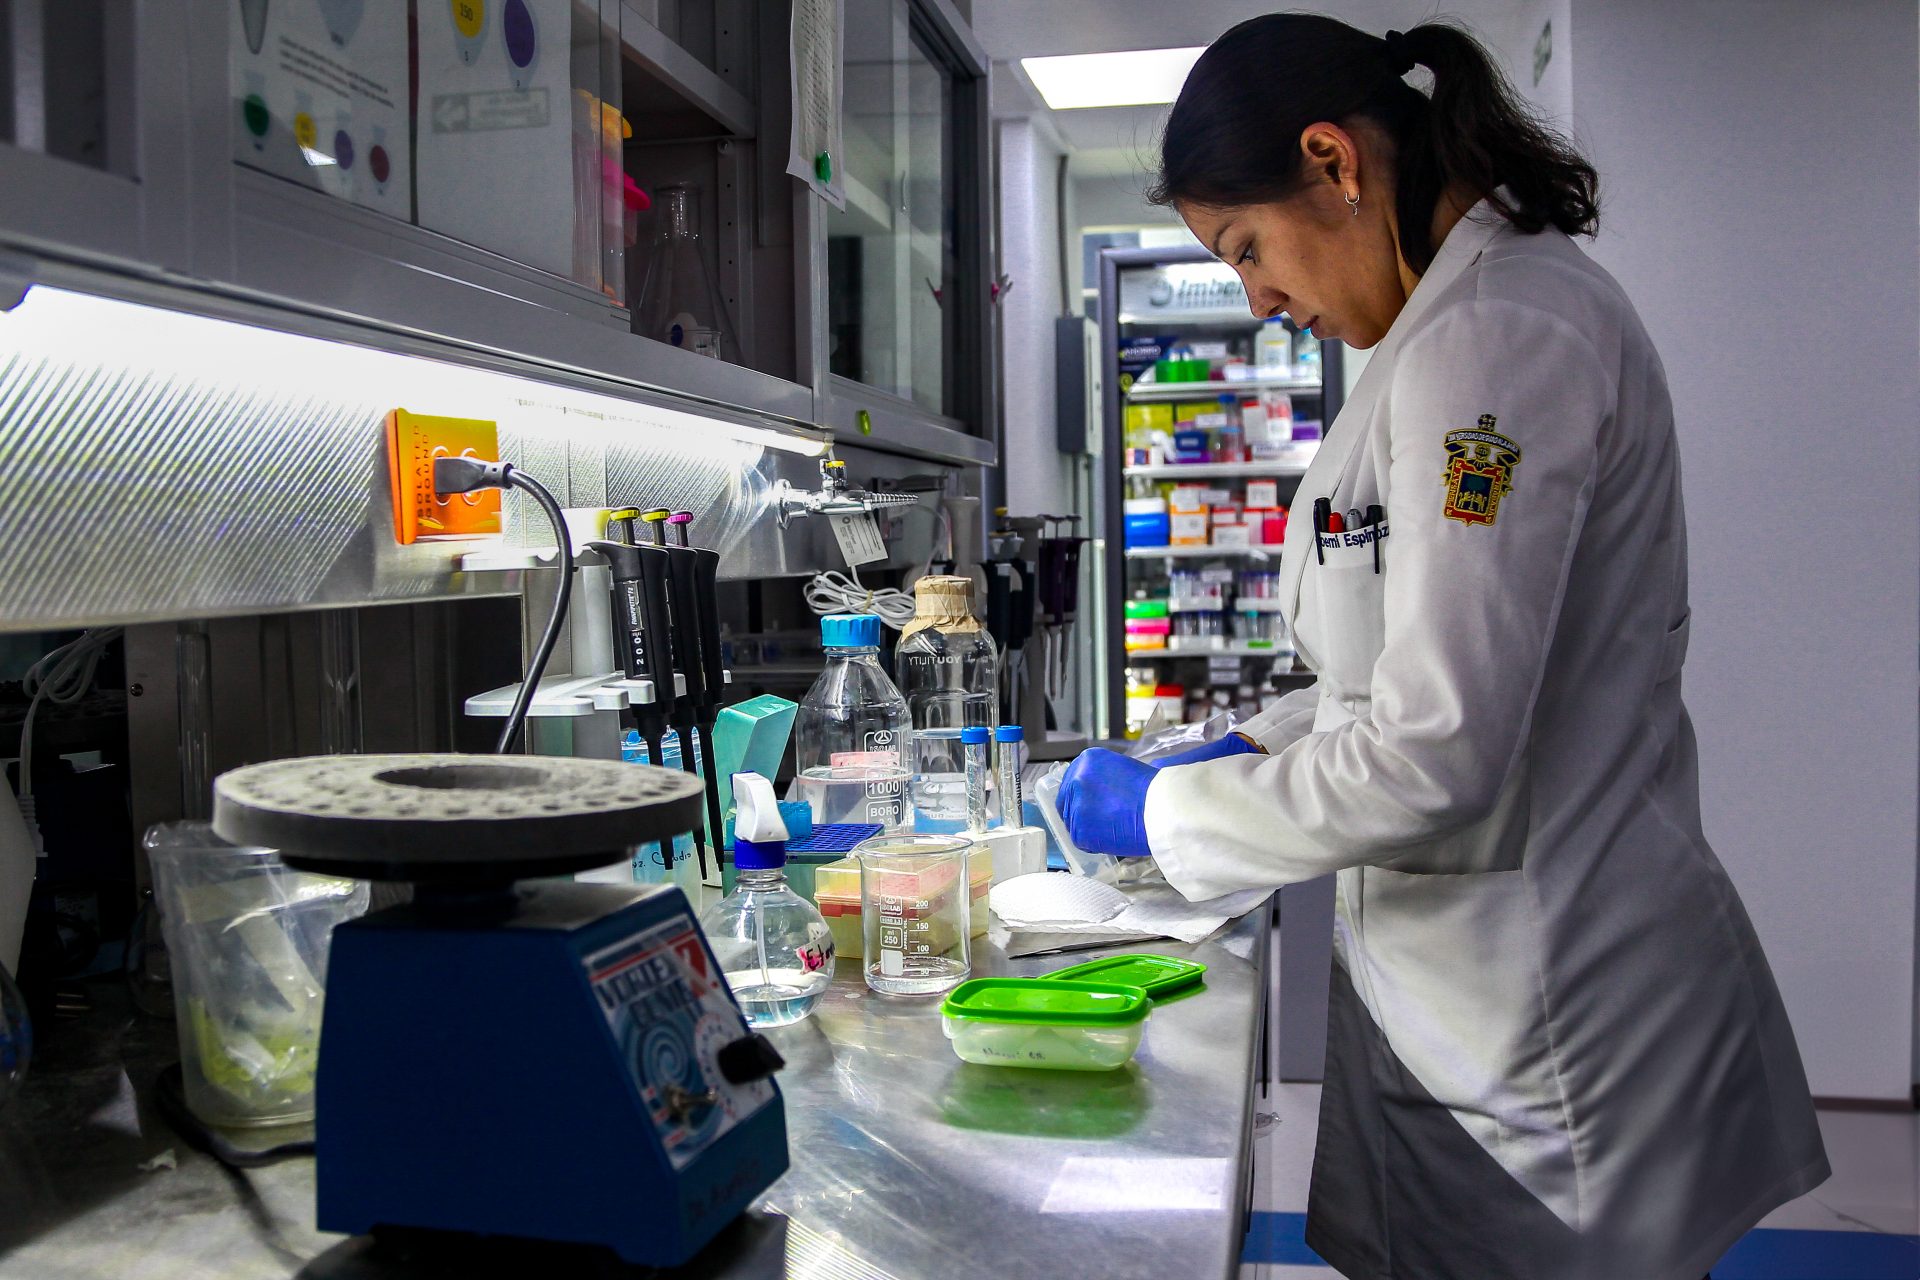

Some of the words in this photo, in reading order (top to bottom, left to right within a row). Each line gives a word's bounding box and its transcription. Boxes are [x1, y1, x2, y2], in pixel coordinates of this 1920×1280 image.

[868, 780, 900, 795] 1000
[870, 804, 899, 817] BORO
[884, 936, 898, 944] 250
